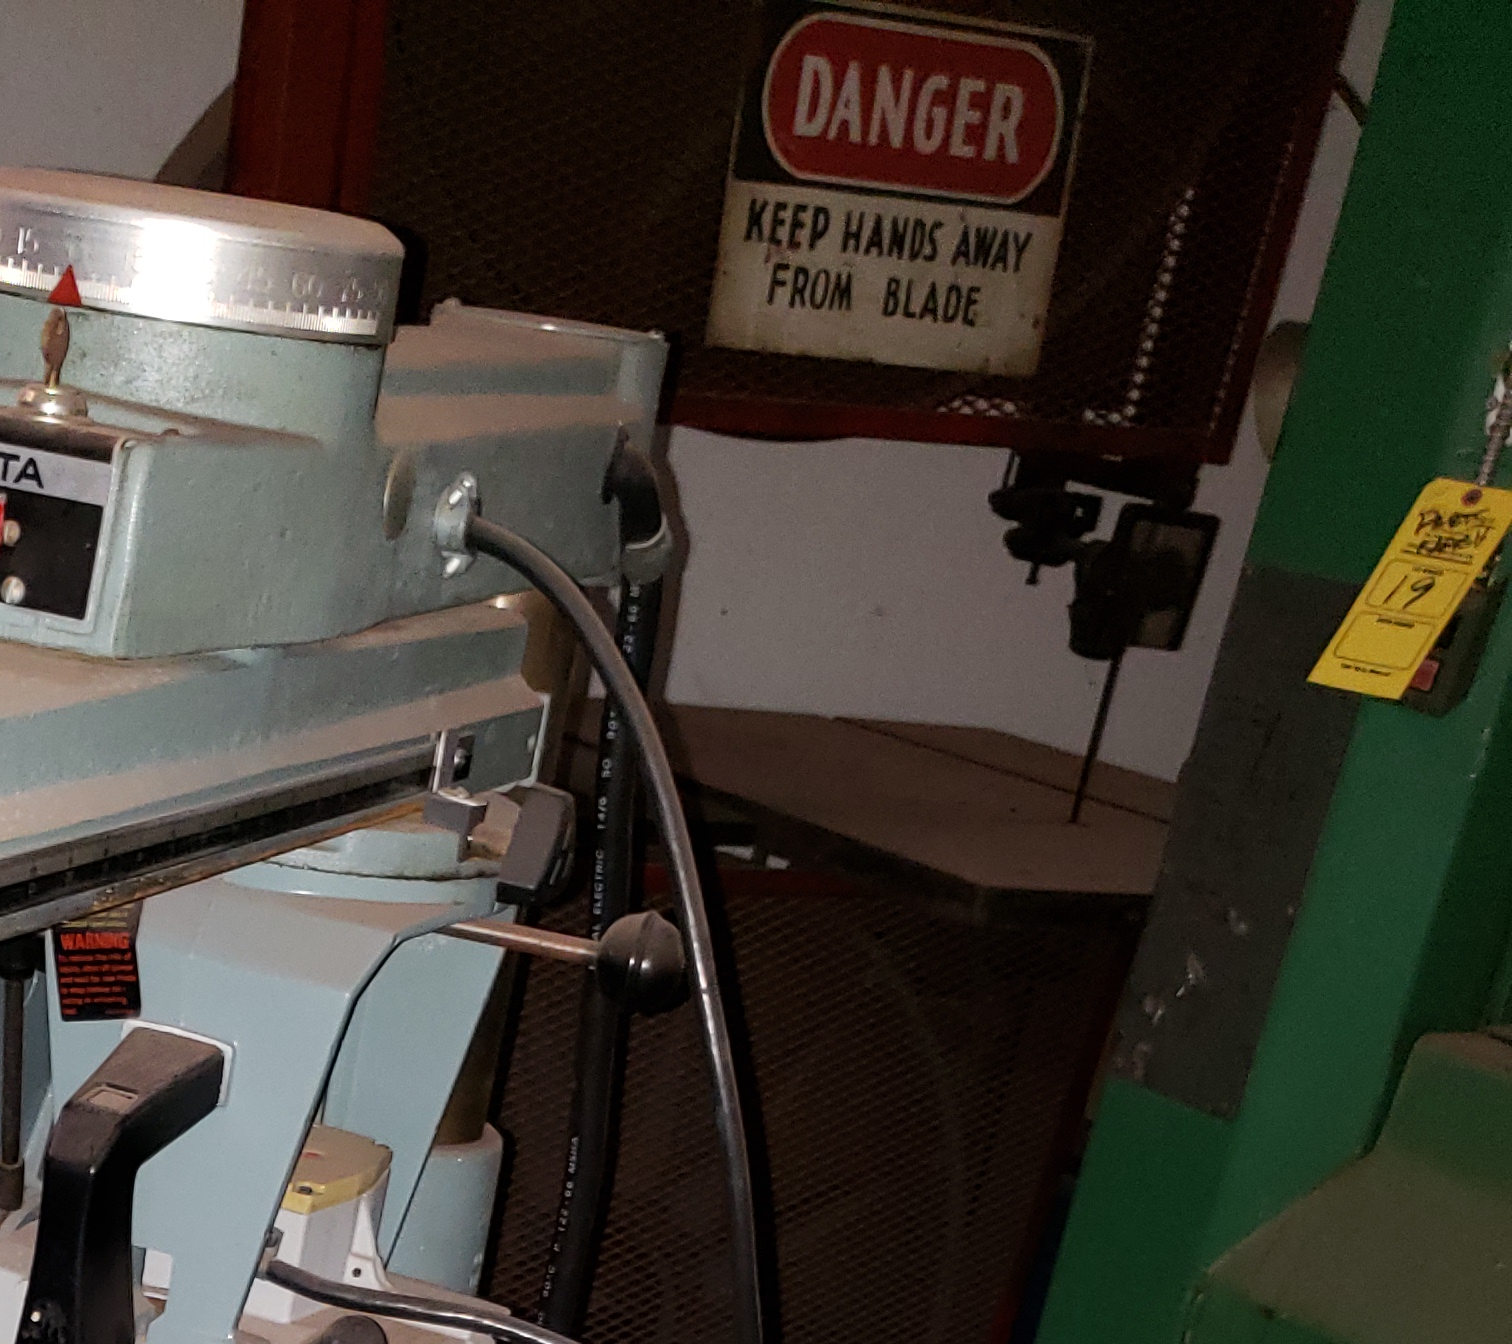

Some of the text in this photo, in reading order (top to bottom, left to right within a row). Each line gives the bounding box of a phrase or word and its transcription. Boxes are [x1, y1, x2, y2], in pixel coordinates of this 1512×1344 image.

[792, 54, 1024, 165] DANGER
[744, 199, 1033, 273] KEEP HANDS AWAY
[767, 262, 982, 328] FROM BLADE
[1382, 575, 1435, 611] 19
[60, 931, 131, 951] WARNING
